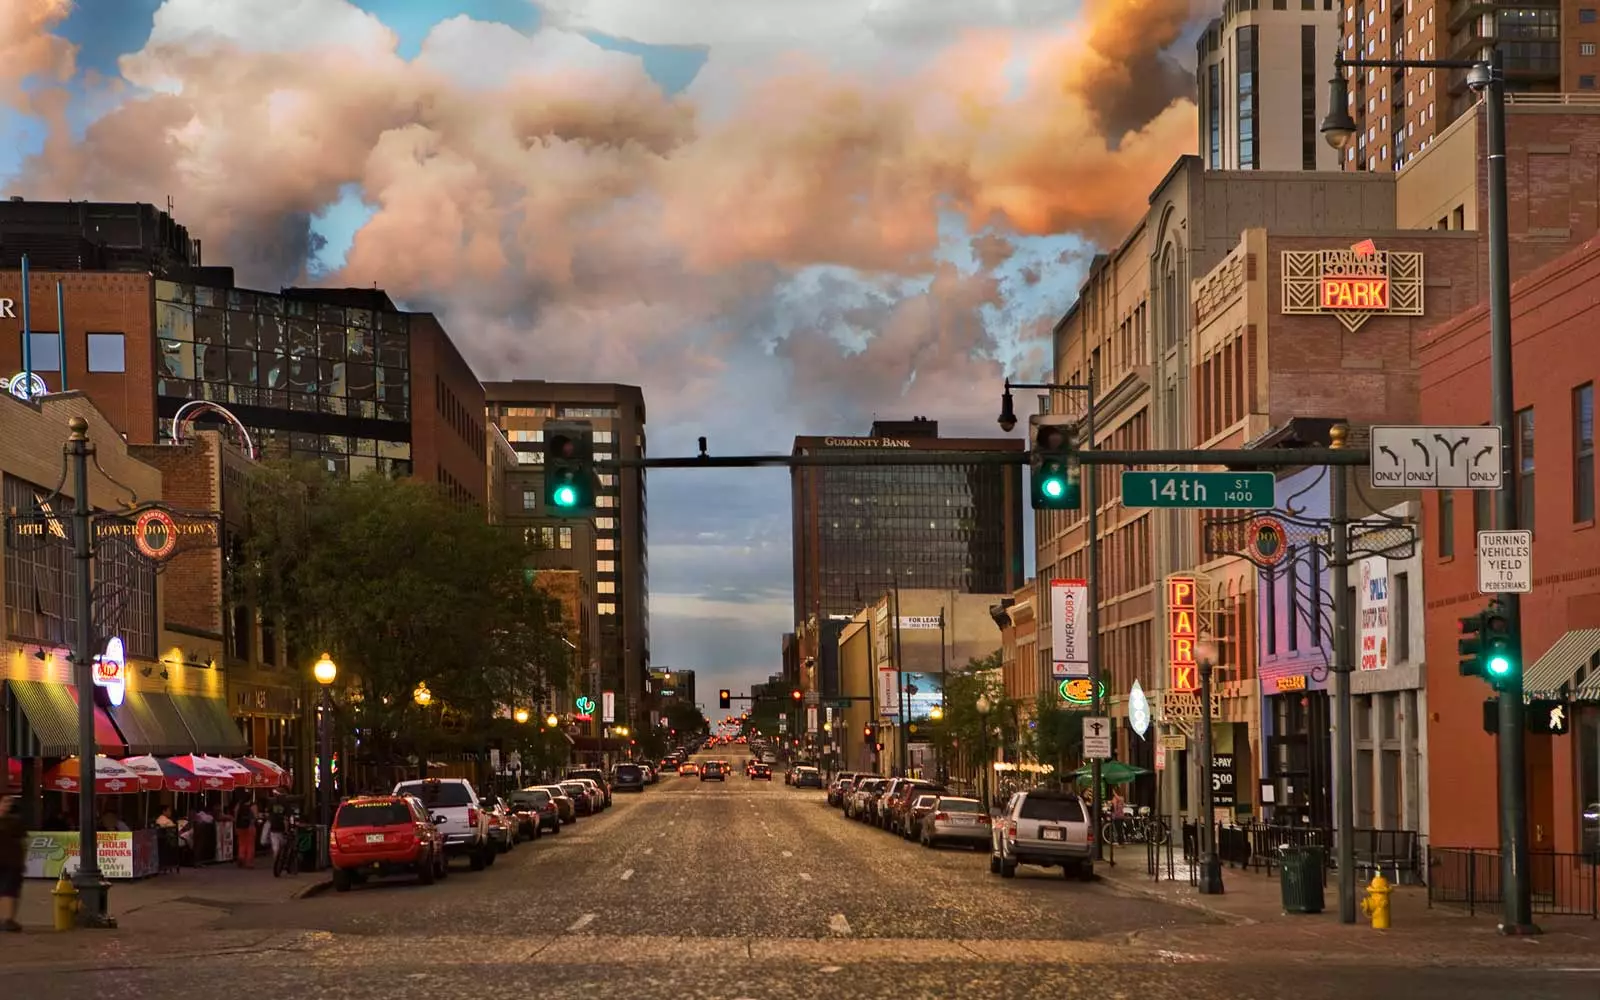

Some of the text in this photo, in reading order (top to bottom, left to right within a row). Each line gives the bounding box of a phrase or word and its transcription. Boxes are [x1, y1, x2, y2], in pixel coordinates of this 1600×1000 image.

[1326, 251, 1384, 264] LARIMER
[1325, 264, 1385, 276] SQUARE
[1325, 281, 1384, 306] PARK
[824, 437, 911, 448] GUARANTY BANK
[1375, 471, 1497, 481] ONLY ONLY ONLY
[1150, 478, 1249, 501] 14th ST
[1224, 491, 1253, 501] 1400
[96, 525, 140, 536] LOWER
[1484, 536, 1526, 545] TURNING
[1481, 547, 1529, 557] VEHICLES
[1488, 560, 1522, 570] YIELD
[1499, 571, 1513, 580] TO
[1485, 582, 1527, 590] PEDESTRIANS
[1175, 583, 1191, 689] PARK
[1166, 692, 1220, 706] LARIMR
[1166, 706, 1219, 718] SQUAE
[102, 841, 128, 849] HOUR
[99, 849, 132, 857] DRINKS
